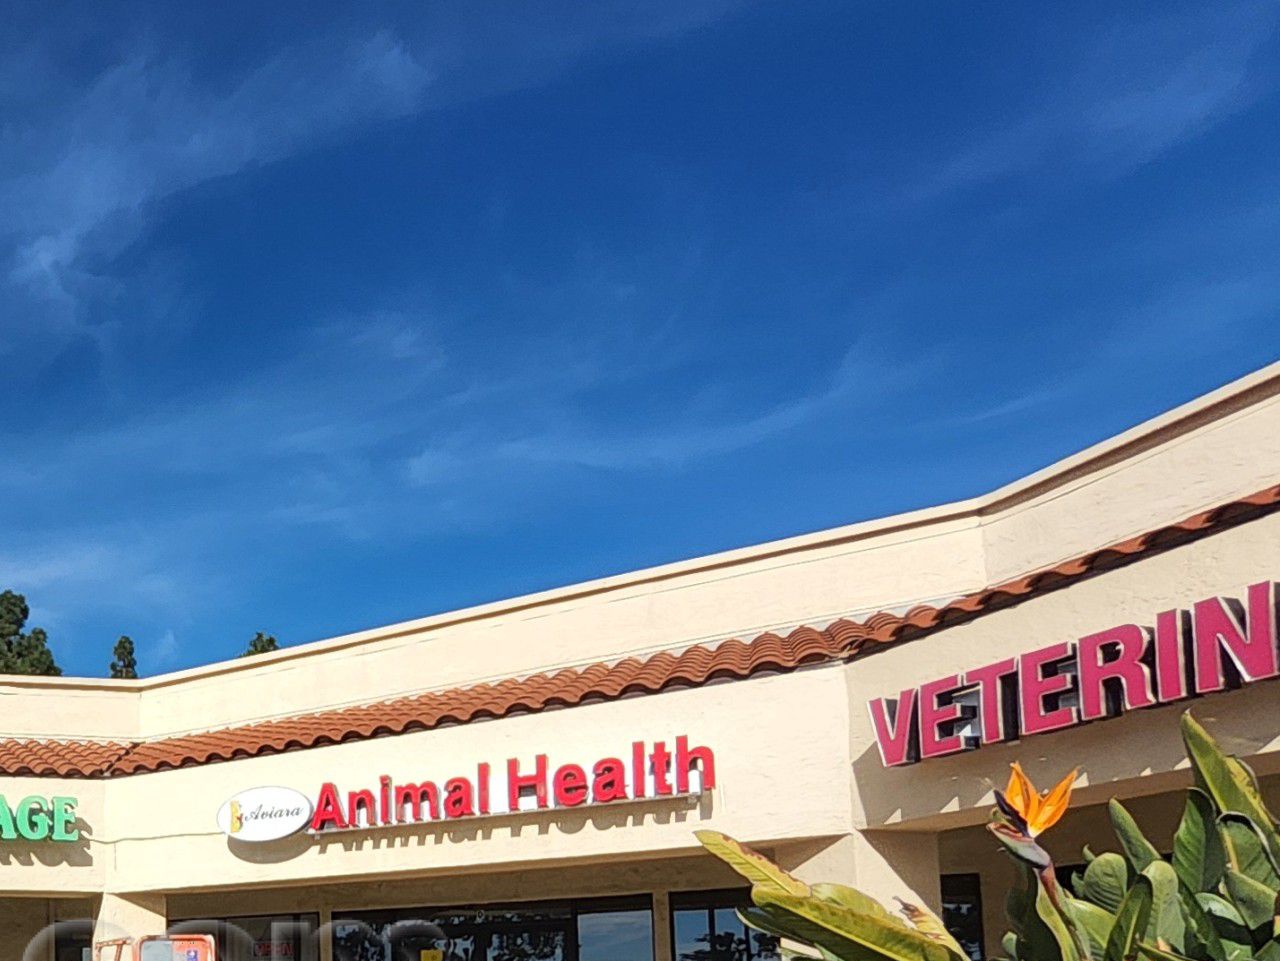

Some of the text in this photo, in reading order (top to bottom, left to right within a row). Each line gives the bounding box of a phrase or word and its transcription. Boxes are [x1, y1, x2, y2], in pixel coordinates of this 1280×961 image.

[867, 580, 1277, 768] VETERIN
[245, 803, 303, 822] Aviara
[311, 735, 716, 832] Animal Health
